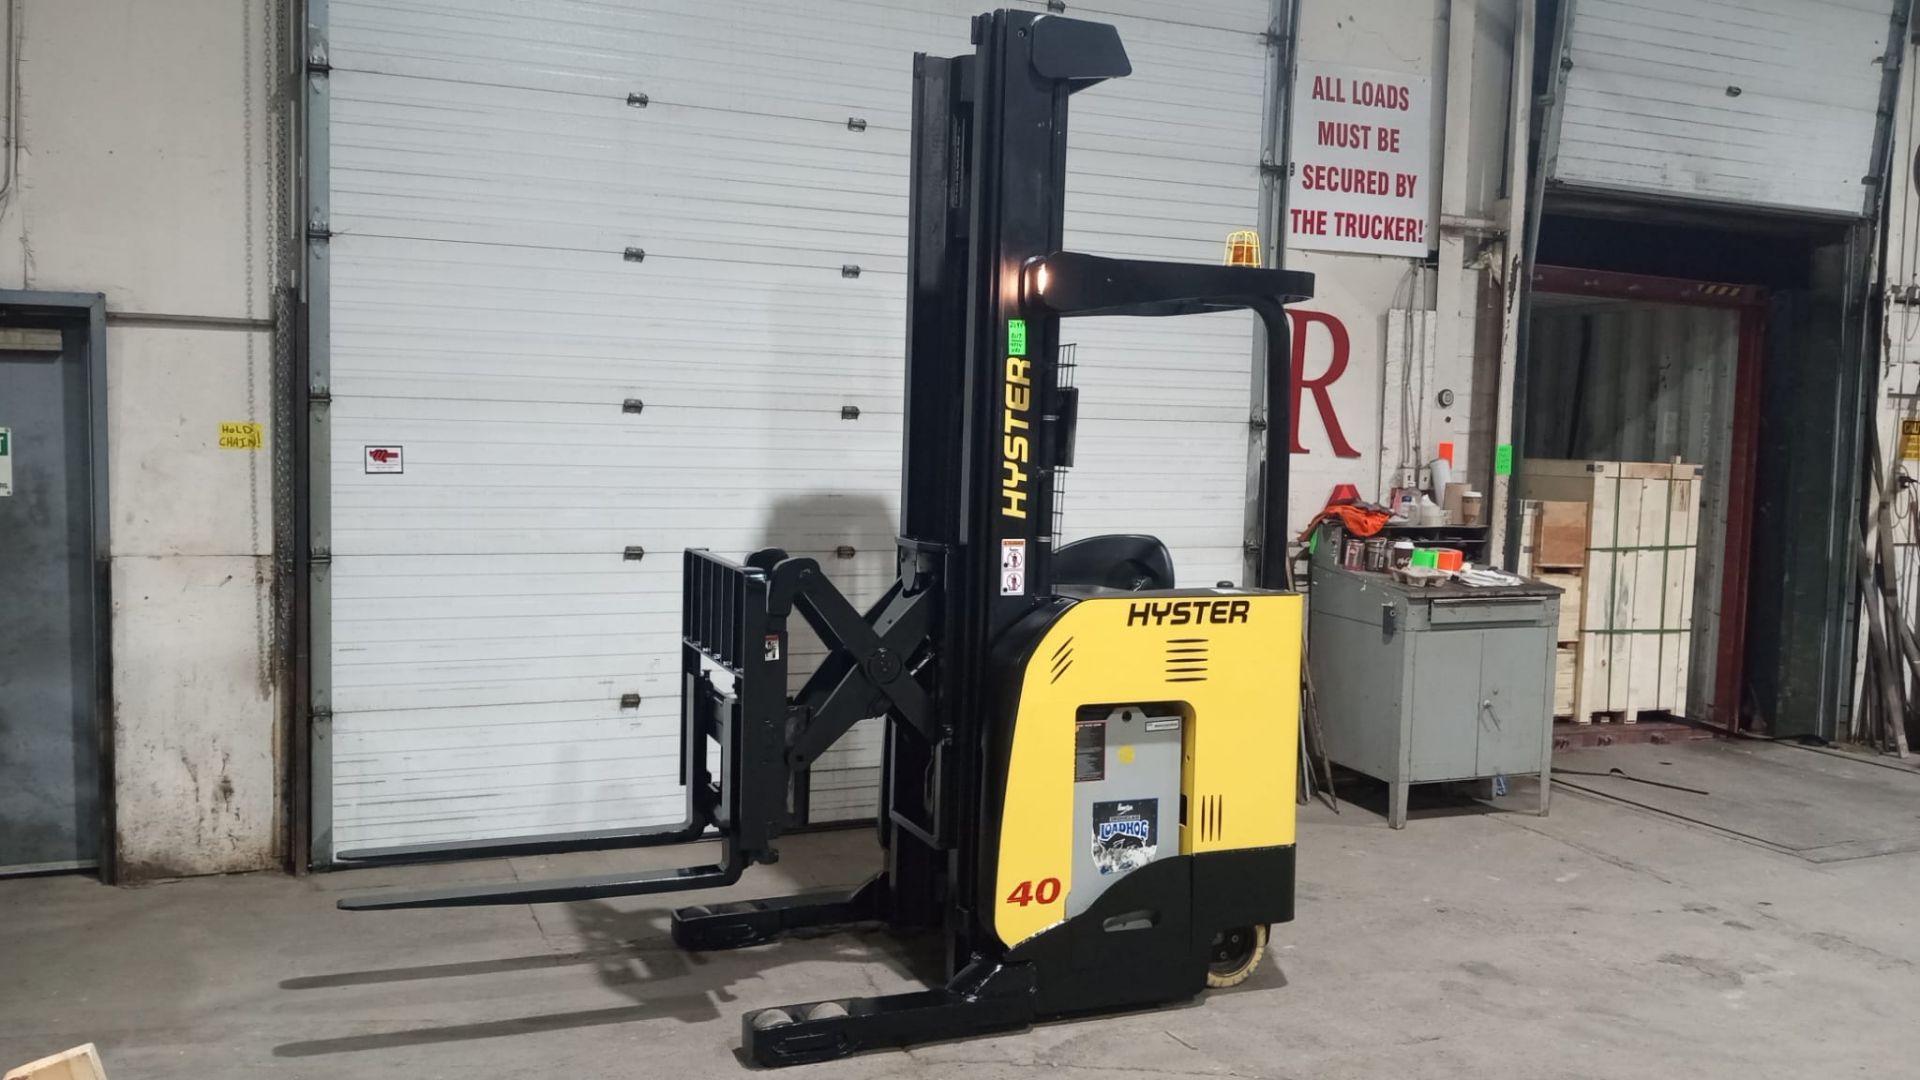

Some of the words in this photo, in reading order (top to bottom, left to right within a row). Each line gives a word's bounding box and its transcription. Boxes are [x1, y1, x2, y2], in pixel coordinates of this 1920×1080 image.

[1312, 75, 1346, 103] ALL
[1352, 80, 1410, 111] LOADS
[1318, 121, 1371, 150] MUST
[1377, 127, 1400, 153] BE
[1302, 164, 1390, 196] SECURED
[1396, 173, 1417, 199] BY
[1290, 209, 1327, 236] THE
[1334, 211, 1424, 243] TRUCKER!
[219, 432, 260, 448] CHAIN!
[1002, 357, 1031, 519] HYSTER
[1127, 600, 1250, 627] HYSTER
[1099, 820, 1149, 841] LOADHOG
[1006, 877, 1061, 907] 40
